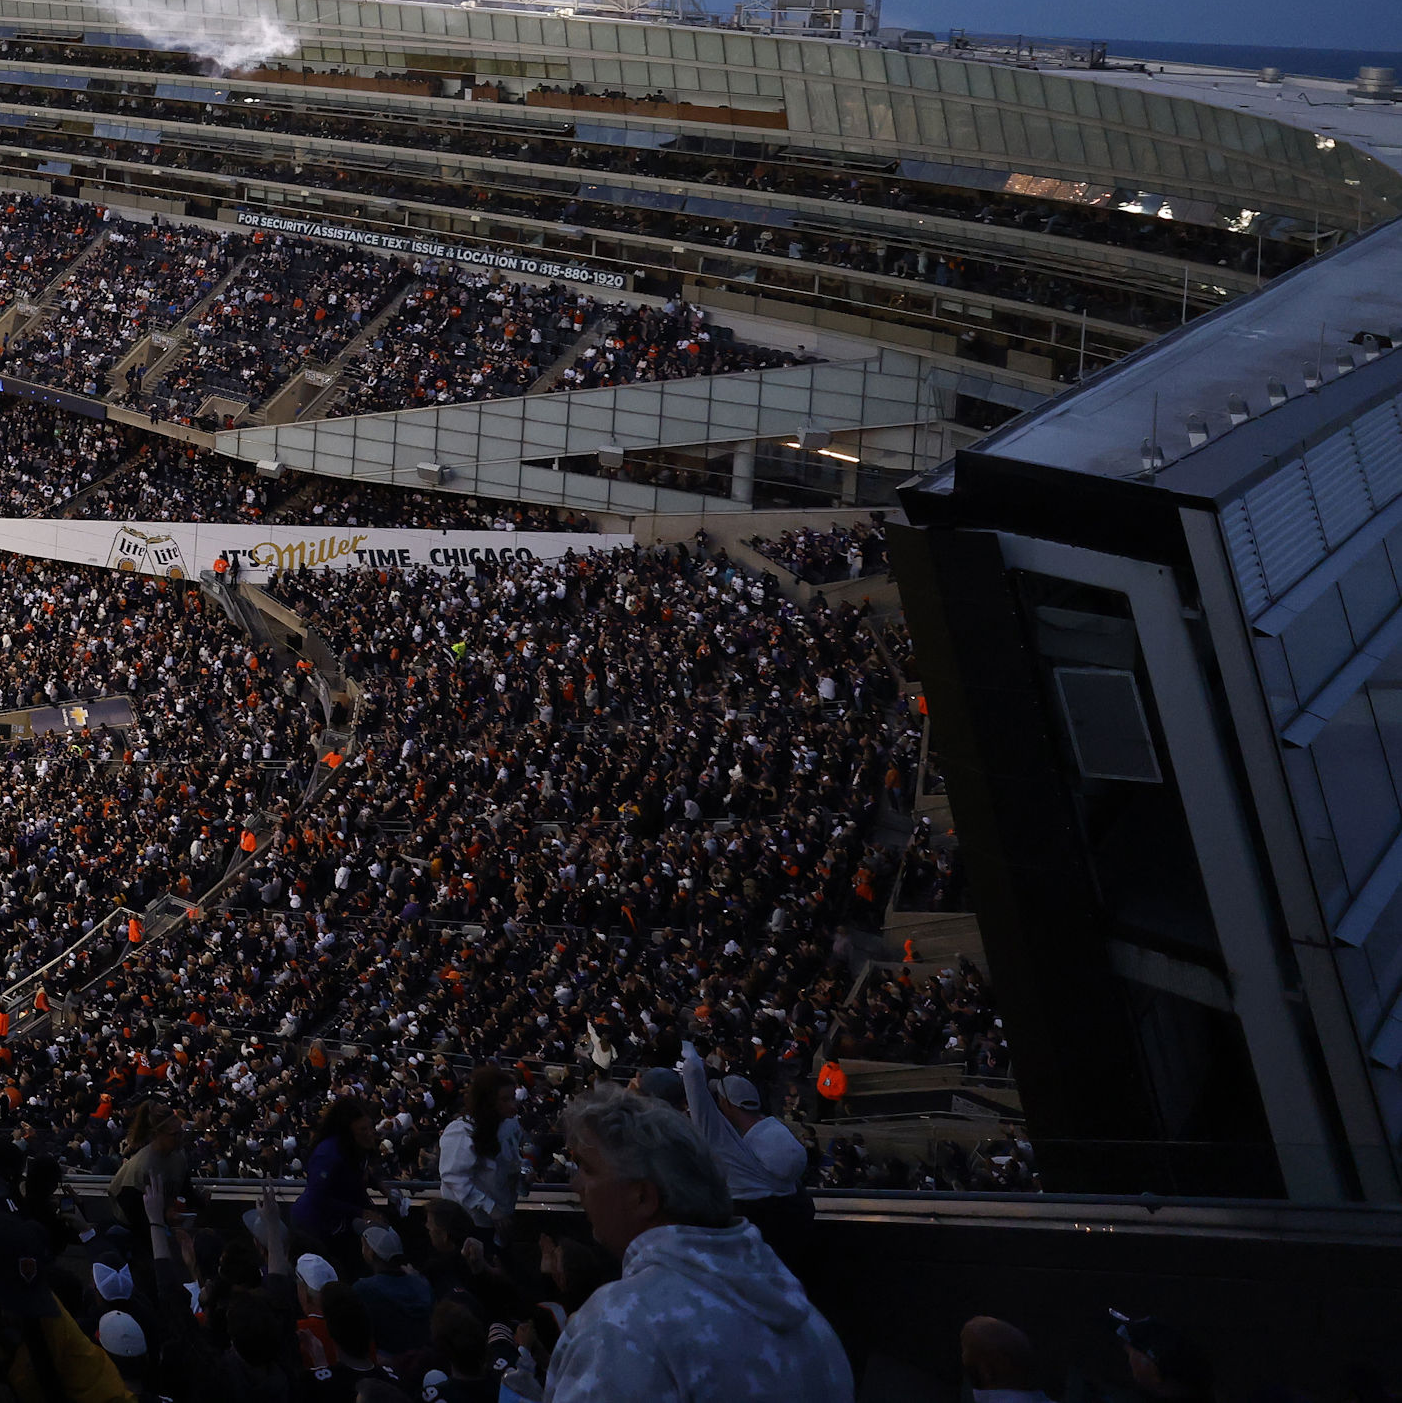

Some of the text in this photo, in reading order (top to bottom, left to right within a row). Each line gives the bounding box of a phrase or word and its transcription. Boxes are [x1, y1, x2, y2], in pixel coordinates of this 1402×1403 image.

[238, 213, 624, 288] FOR SECURITY/ASSISTANCE TEXT ISSUE & LOCATION TO 815-880-1920
[119, 538, 146, 557] Lite
[153, 546, 179, 565] Lite
[252, 535, 367, 579] Miller
